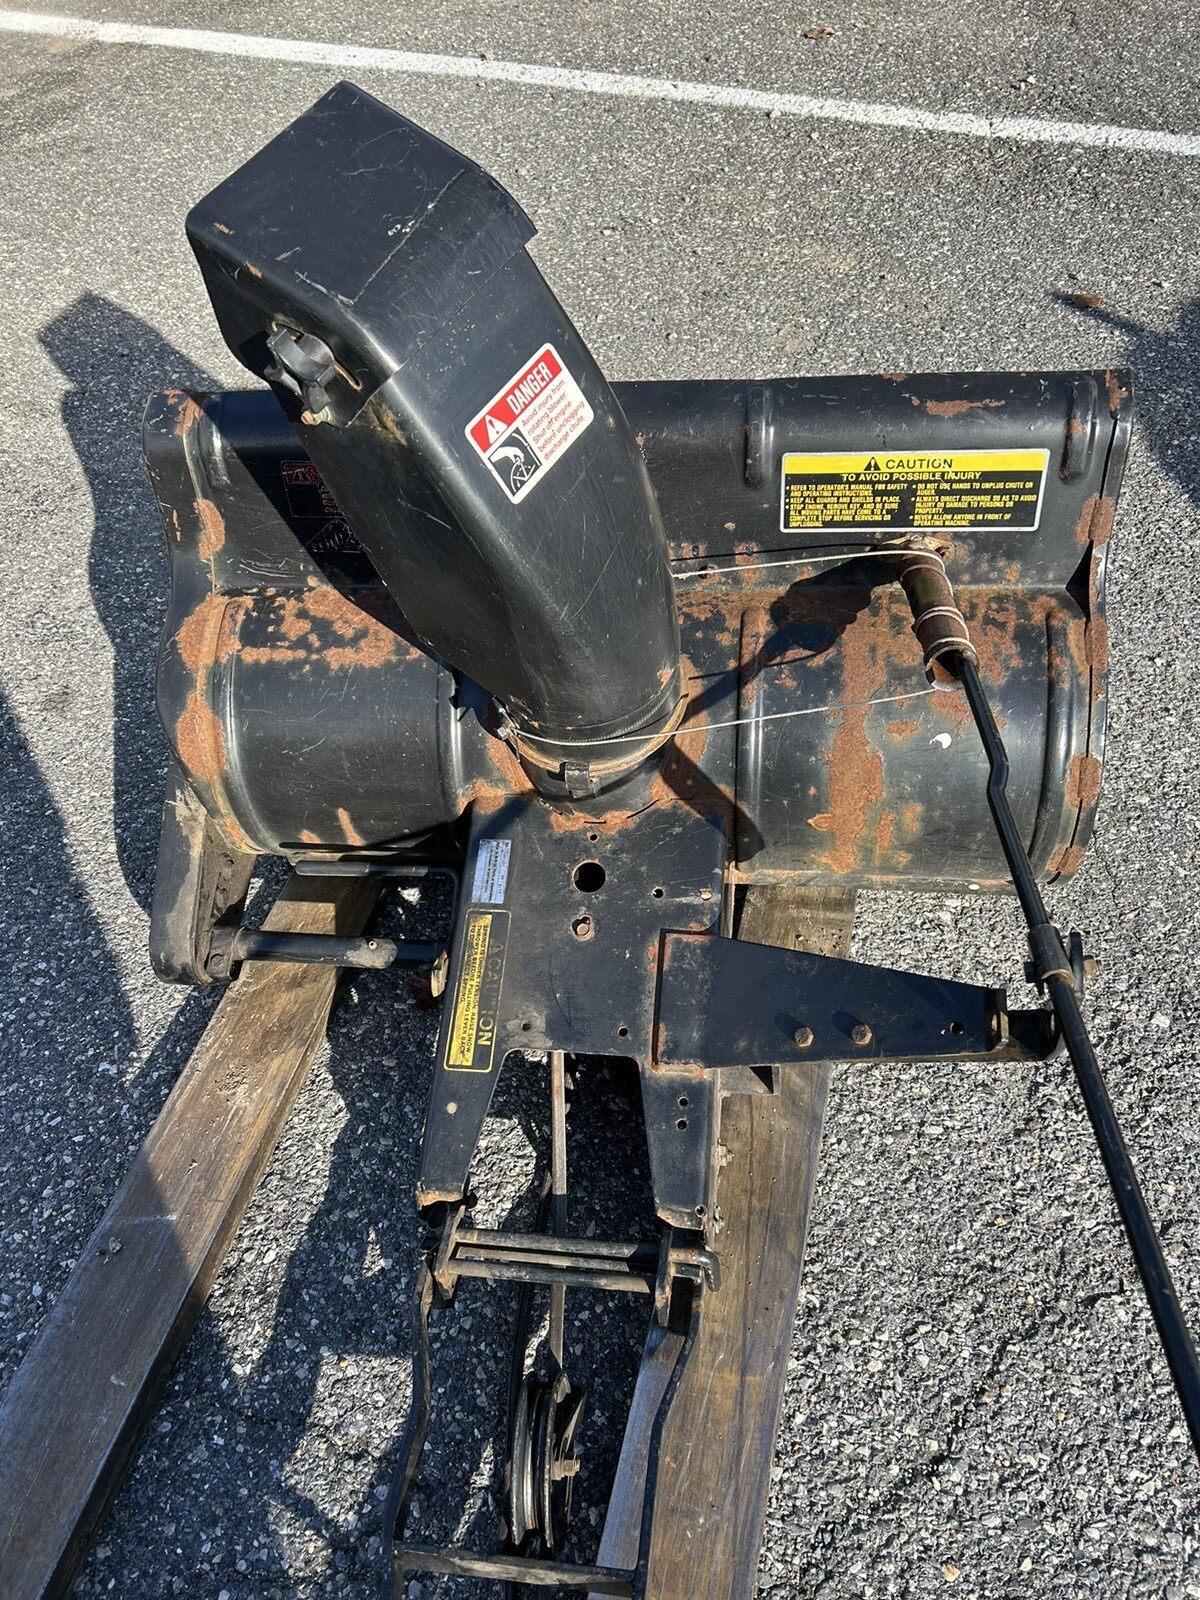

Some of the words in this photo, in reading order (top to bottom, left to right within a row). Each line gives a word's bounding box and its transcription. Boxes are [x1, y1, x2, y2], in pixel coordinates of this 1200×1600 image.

[505, 359, 553, 416] DANGER
[520, 407, 538, 427] Avoid
[536, 391, 553, 412] injury
[550, 377, 565, 394] from
[526, 410, 549, 436] rotating
[532, 426, 547, 444] Shut
[544, 416, 556, 430] off
[553, 400, 573, 423] engine
[537, 430, 557, 452] before
[554, 399, 585, 434] unclogging
[542, 429, 570, 461] discharge
[886, 459, 953, 469] CAUTION
[842, 473, 855, 481] TO
[470, 925, 476, 933] TO
[472, 925, 482, 955] THROWER
[469, 957, 477, 980] BEFORE
[476, 956, 484, 978] UNDER
[464, 983, 474, 1011] PULLING
[461, 1013, 469, 1034] LEVER
[468, 1011, 476, 1031] RAISE
[458, 1036, 466, 1054] BACK
[465, 1032, 473, 1052] SNOW
